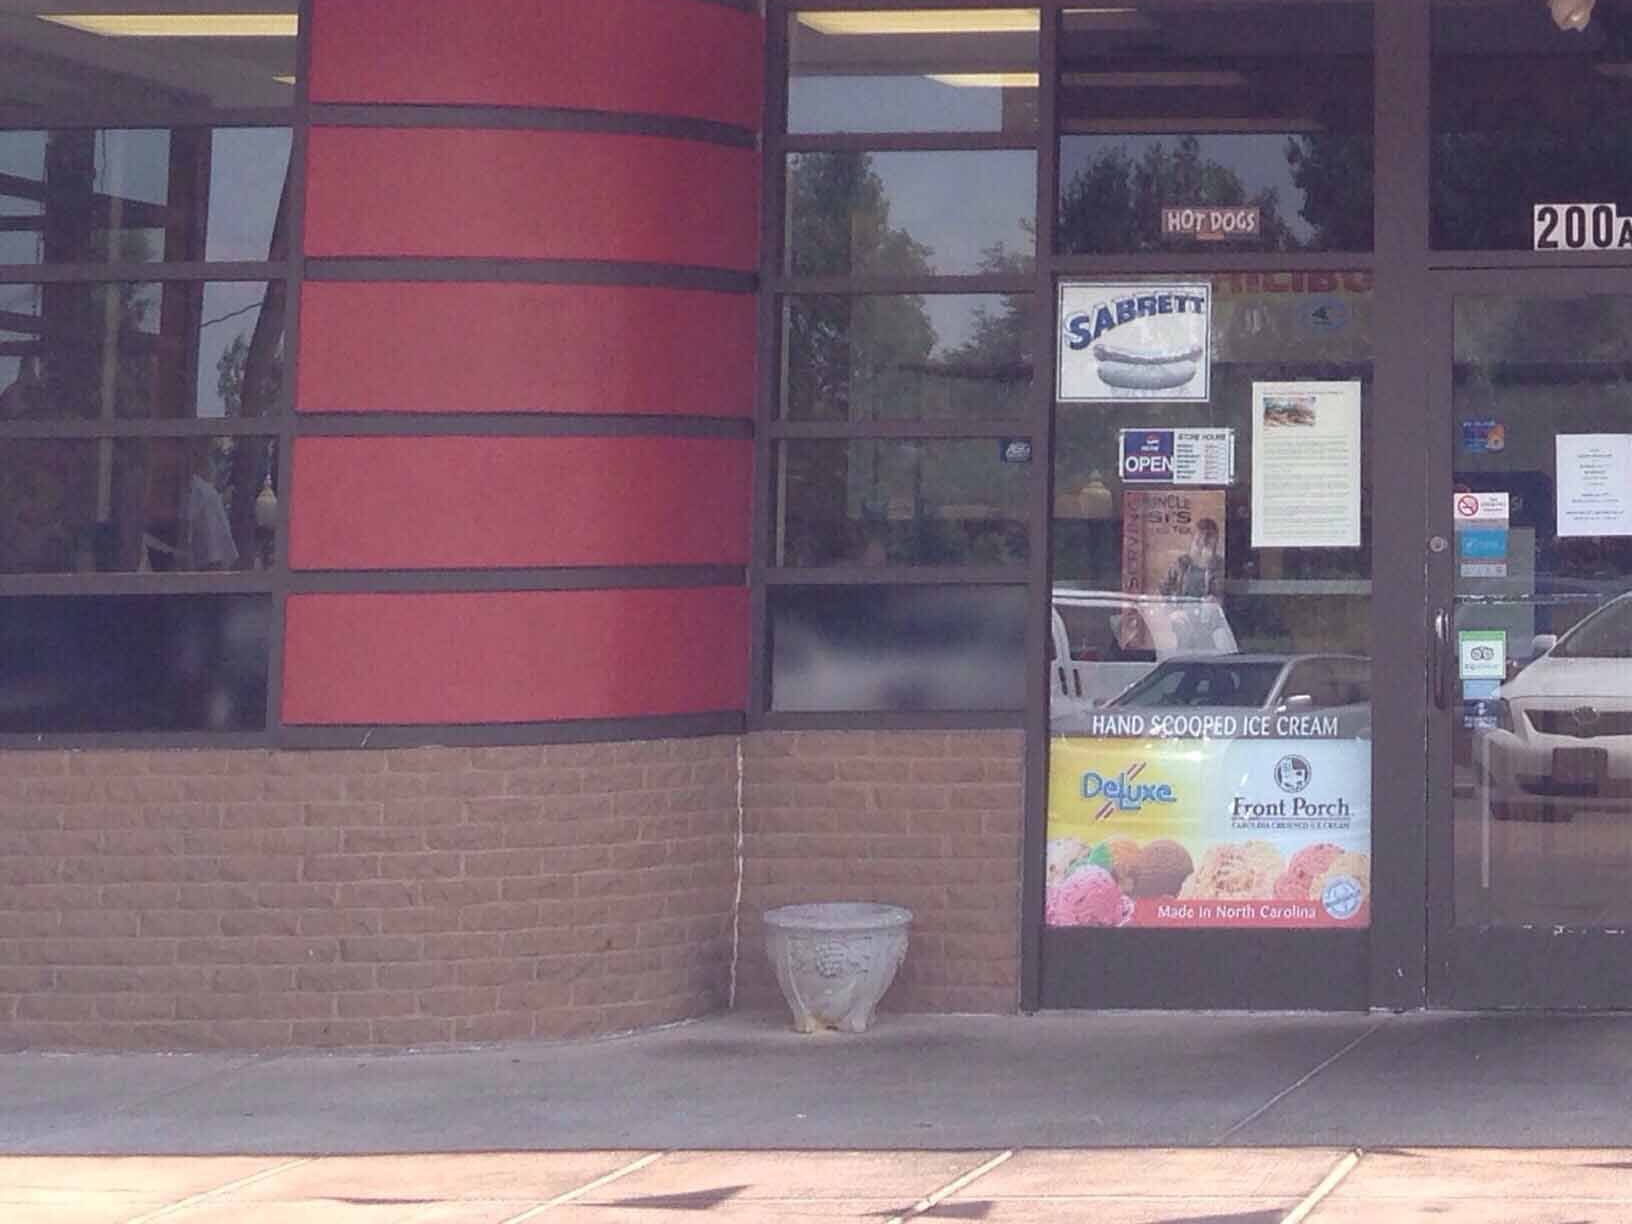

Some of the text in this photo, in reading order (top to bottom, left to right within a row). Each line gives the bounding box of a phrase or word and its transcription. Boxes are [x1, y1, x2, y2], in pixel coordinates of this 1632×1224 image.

[1167, 209, 1256, 233] HOT DOGS
[1066, 293, 1206, 351] SABRETT
[1125, 455, 1174, 473] OPEN
[1092, 714, 1338, 736] HAND SCOOPED ICE CREAM
[1232, 796, 1350, 816] Front Porch
[1157, 905, 1194, 919] Made
[1216, 904, 1255, 919] North
[1260, 904, 1316, 919] Carolina
